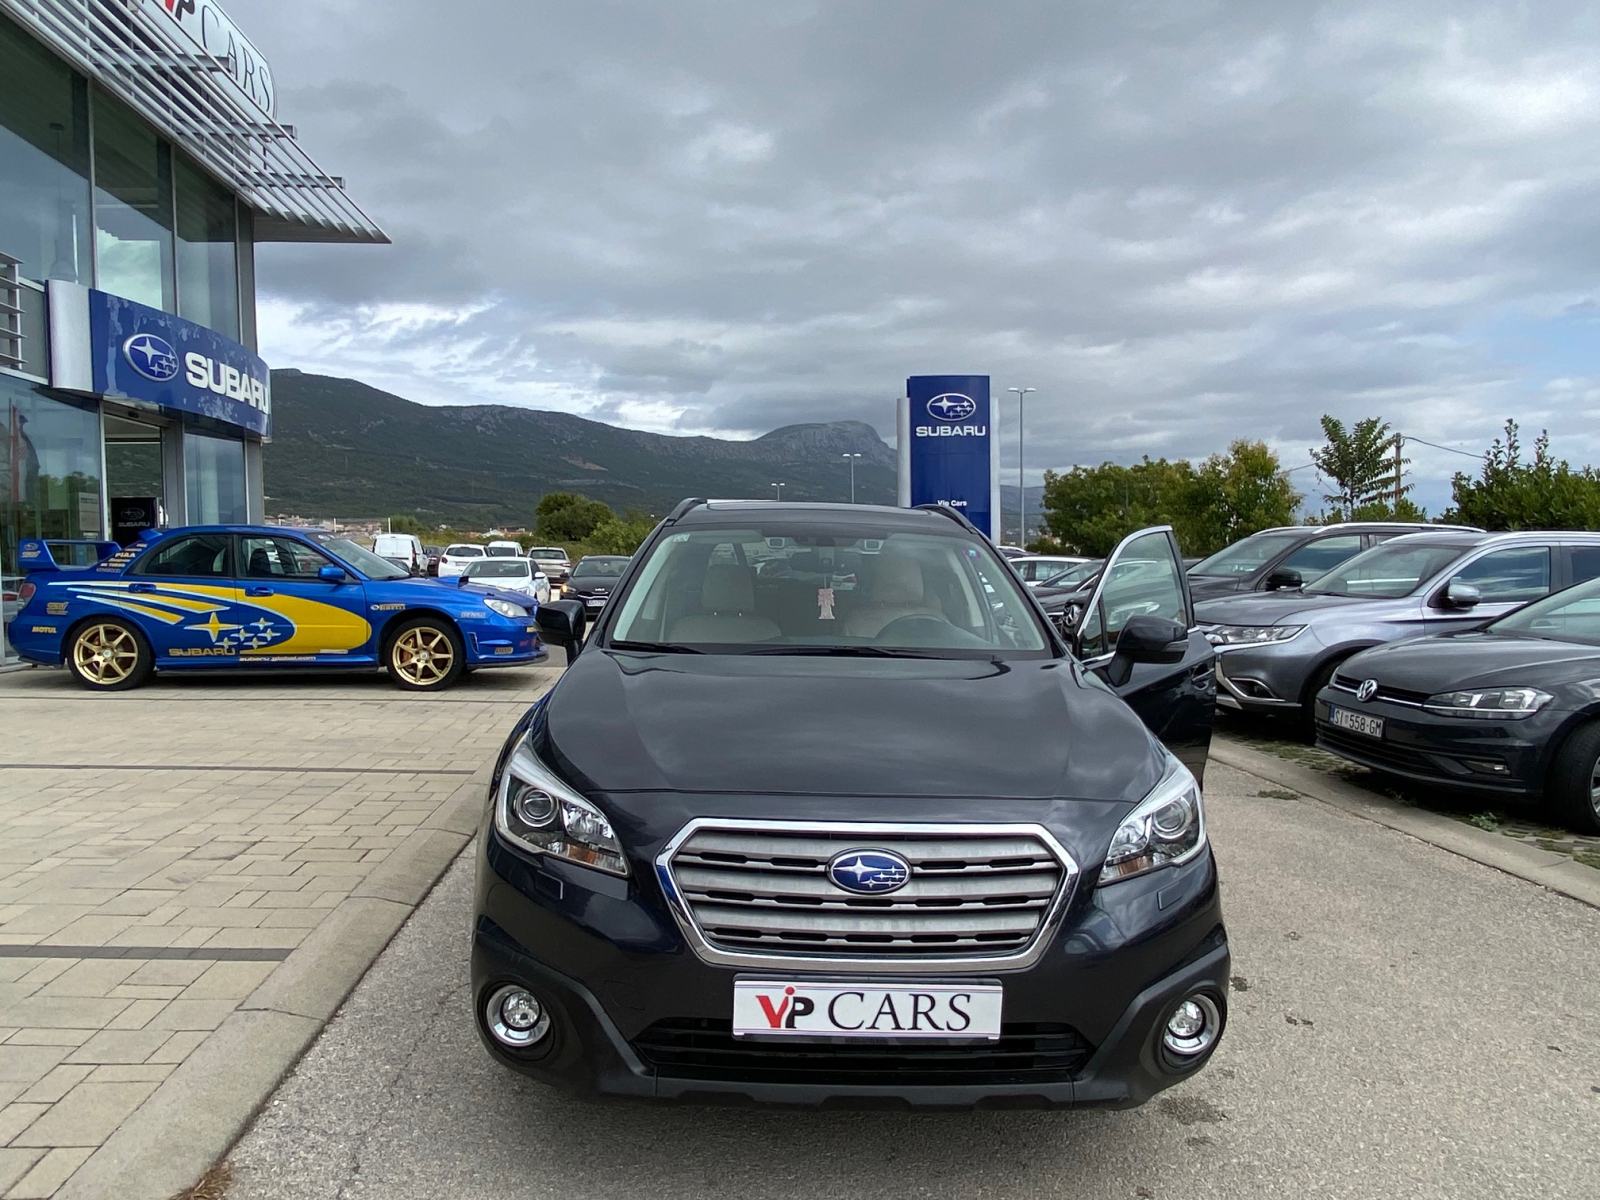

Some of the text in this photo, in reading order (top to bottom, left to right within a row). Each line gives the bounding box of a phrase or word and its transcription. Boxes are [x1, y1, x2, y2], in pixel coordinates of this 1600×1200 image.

[185, 351, 268, 414] SUBARU
[916, 425, 986, 437] SUBARU
[169, 647, 236, 656] SUBARU
[827, 991, 972, 1032] CARS
